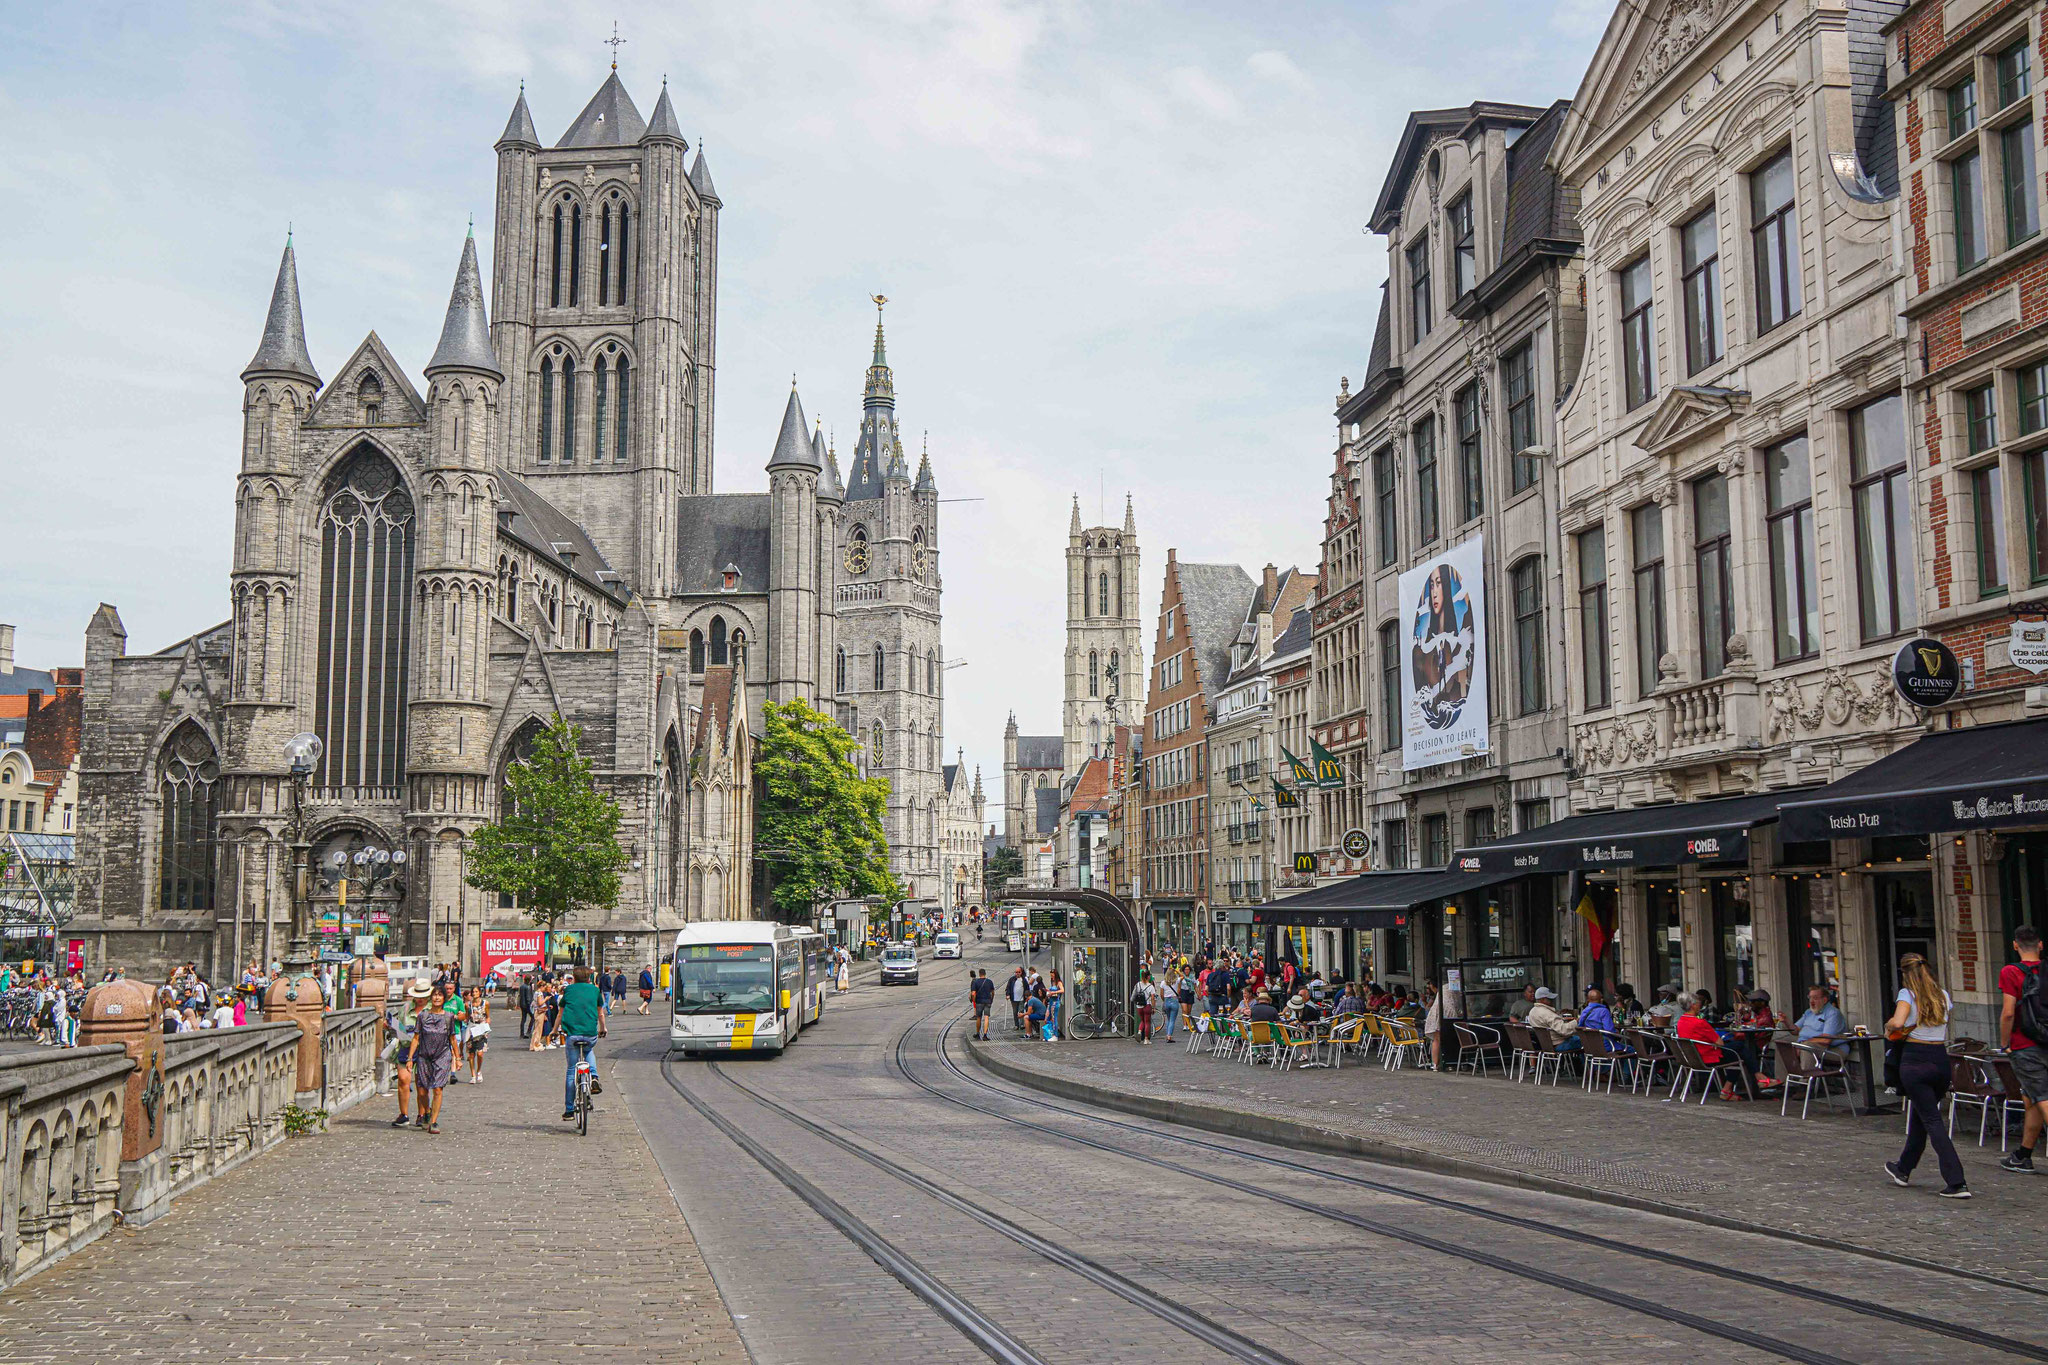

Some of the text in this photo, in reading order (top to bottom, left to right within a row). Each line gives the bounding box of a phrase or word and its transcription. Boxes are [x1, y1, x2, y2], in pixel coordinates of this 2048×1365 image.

[1908, 676, 1953, 688] GUINNESS
[1413, 728, 1476, 752] DECISION TO LEAVE
[1952, 799, 1976, 819] The
[1976, 796, 2013, 818] Celtic
[1829, 812, 1880, 829] Irish Pub
[1514, 855, 1539, 867] Irish Pub
[486, 935, 540, 951] INSIDE DALÍ
[697, 946, 704, 958] 3
